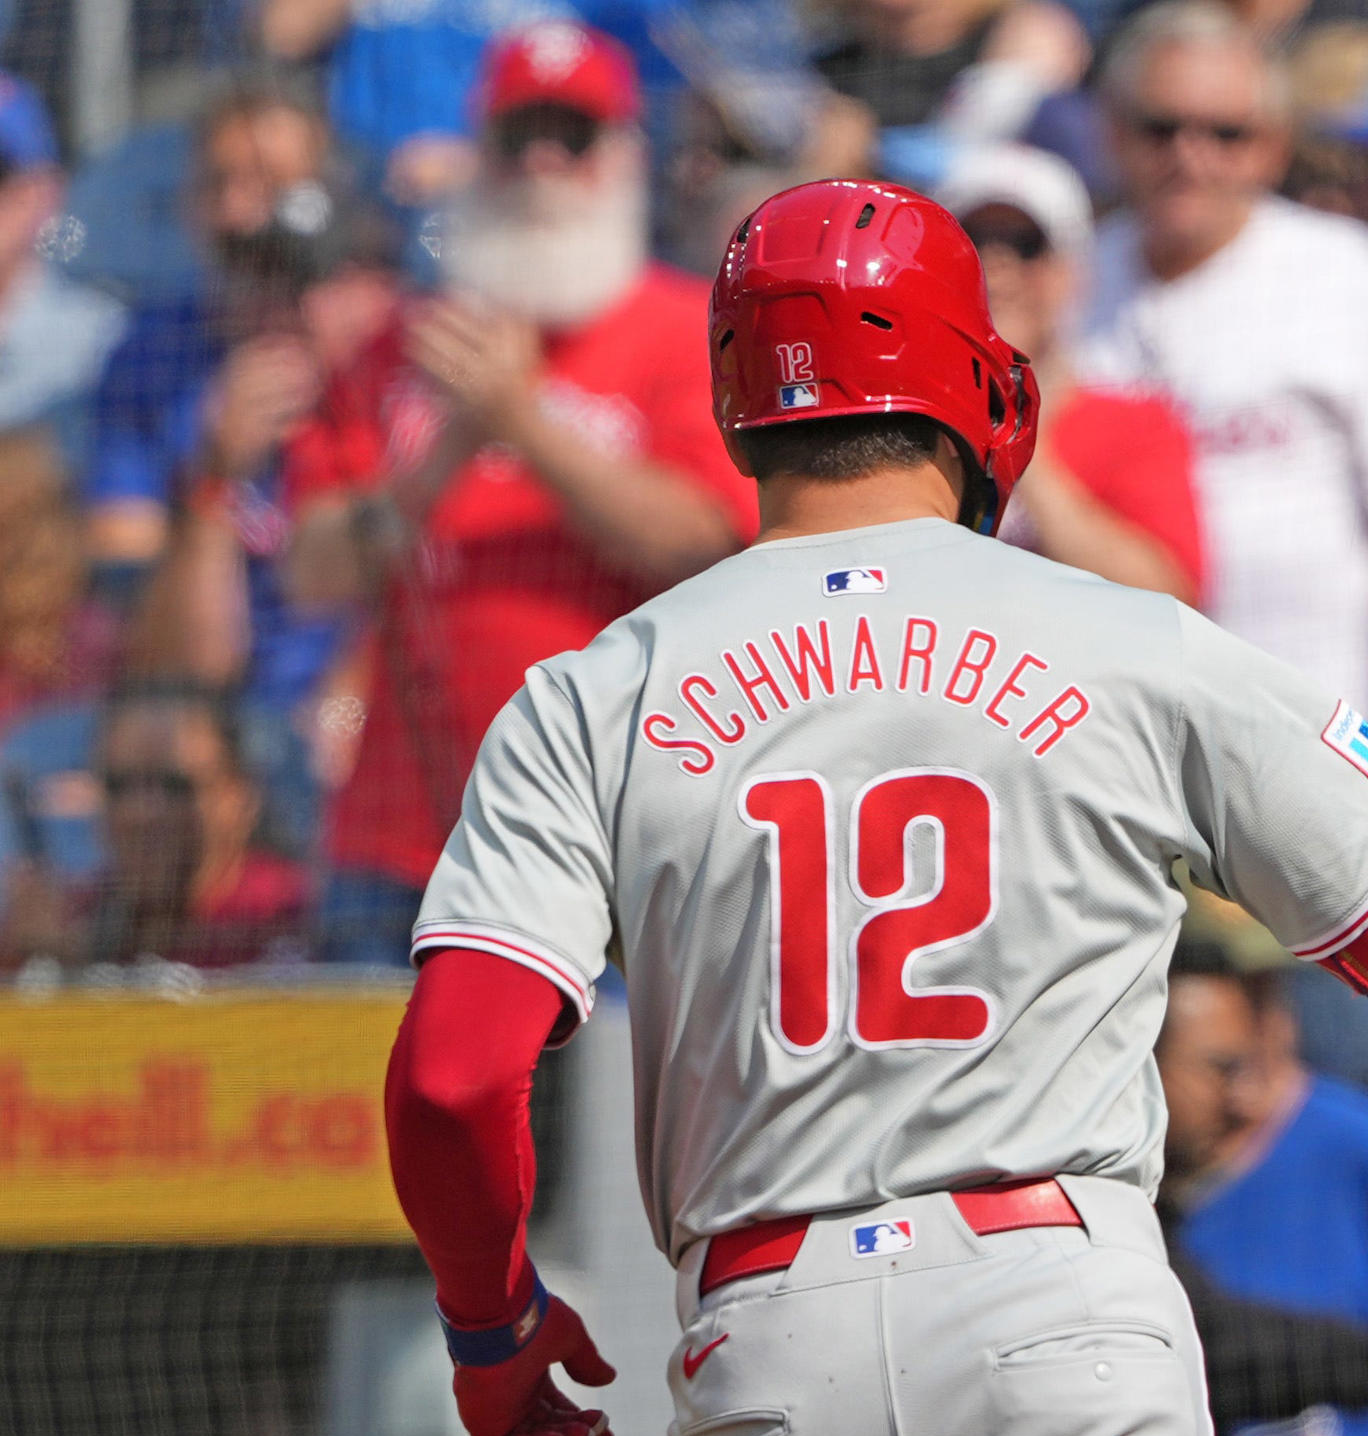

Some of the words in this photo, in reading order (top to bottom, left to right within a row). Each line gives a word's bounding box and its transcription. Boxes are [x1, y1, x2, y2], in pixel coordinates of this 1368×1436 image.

[776, 342, 814, 383] 12
[640, 614, 1092, 778] SCHWARBER
[737, 766, 1000, 1056] 12
